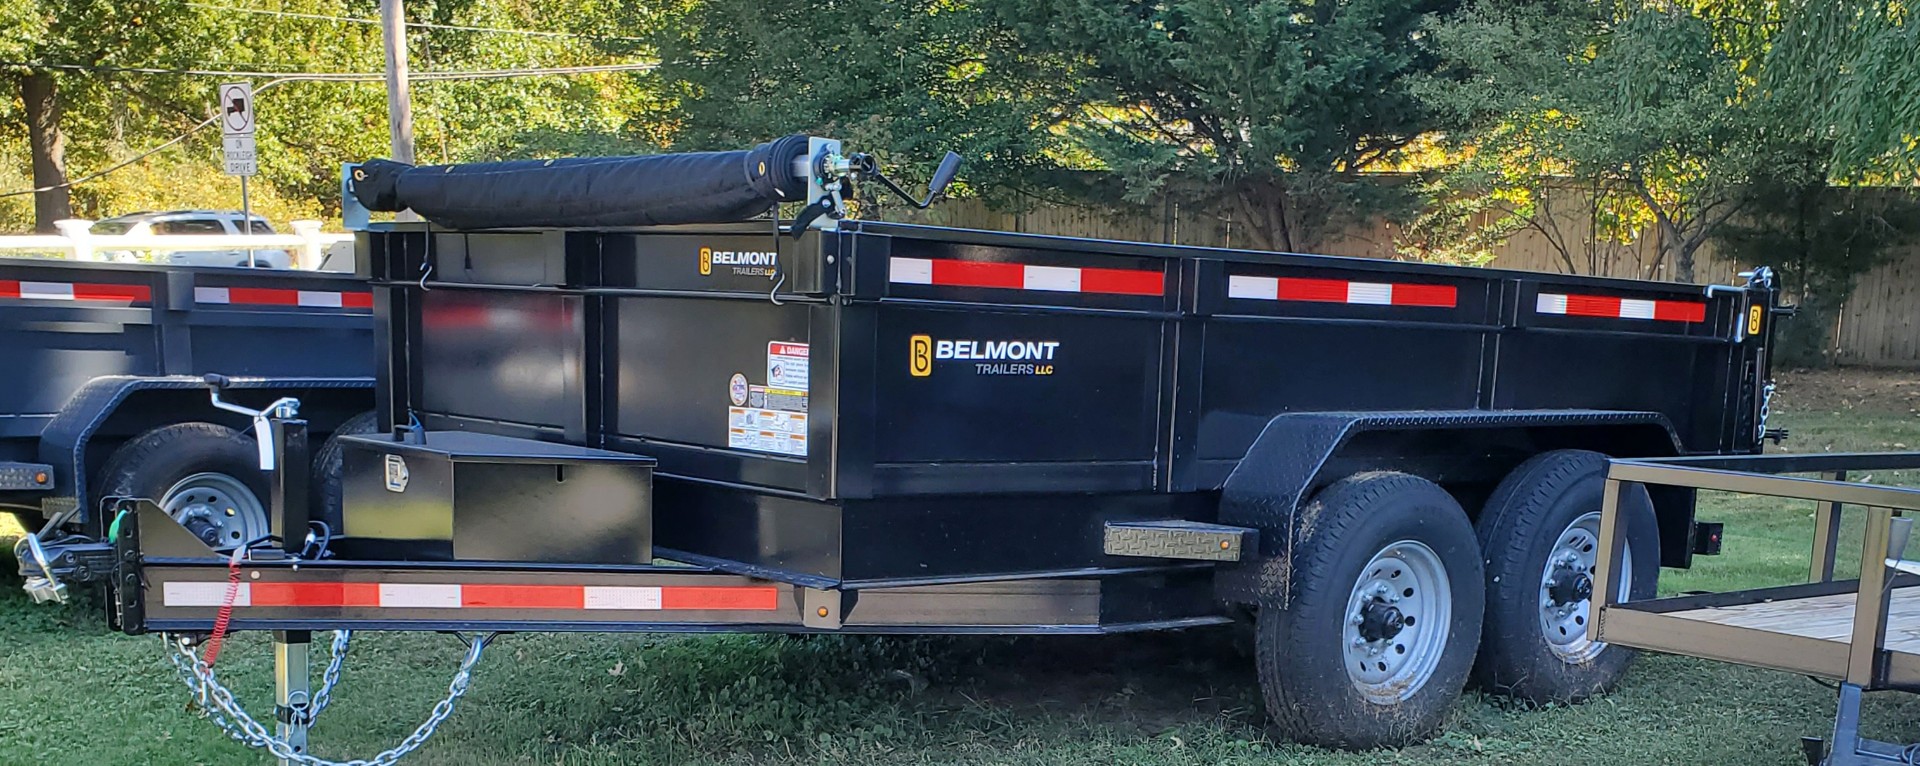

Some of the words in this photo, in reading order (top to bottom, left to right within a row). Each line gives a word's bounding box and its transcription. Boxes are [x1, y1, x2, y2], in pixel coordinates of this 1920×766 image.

[230, 162, 251, 172] DRIVE
[712, 251, 777, 265] BELMONT
[733, 267, 764, 275] TRAILERS
[786, 346, 808, 356] DANGE
[914, 339, 929, 373] B
[935, 340, 1060, 360] BELMONT
[975, 363, 1034, 375] TRAILERS
[1034, 365, 1054, 375] LLC
